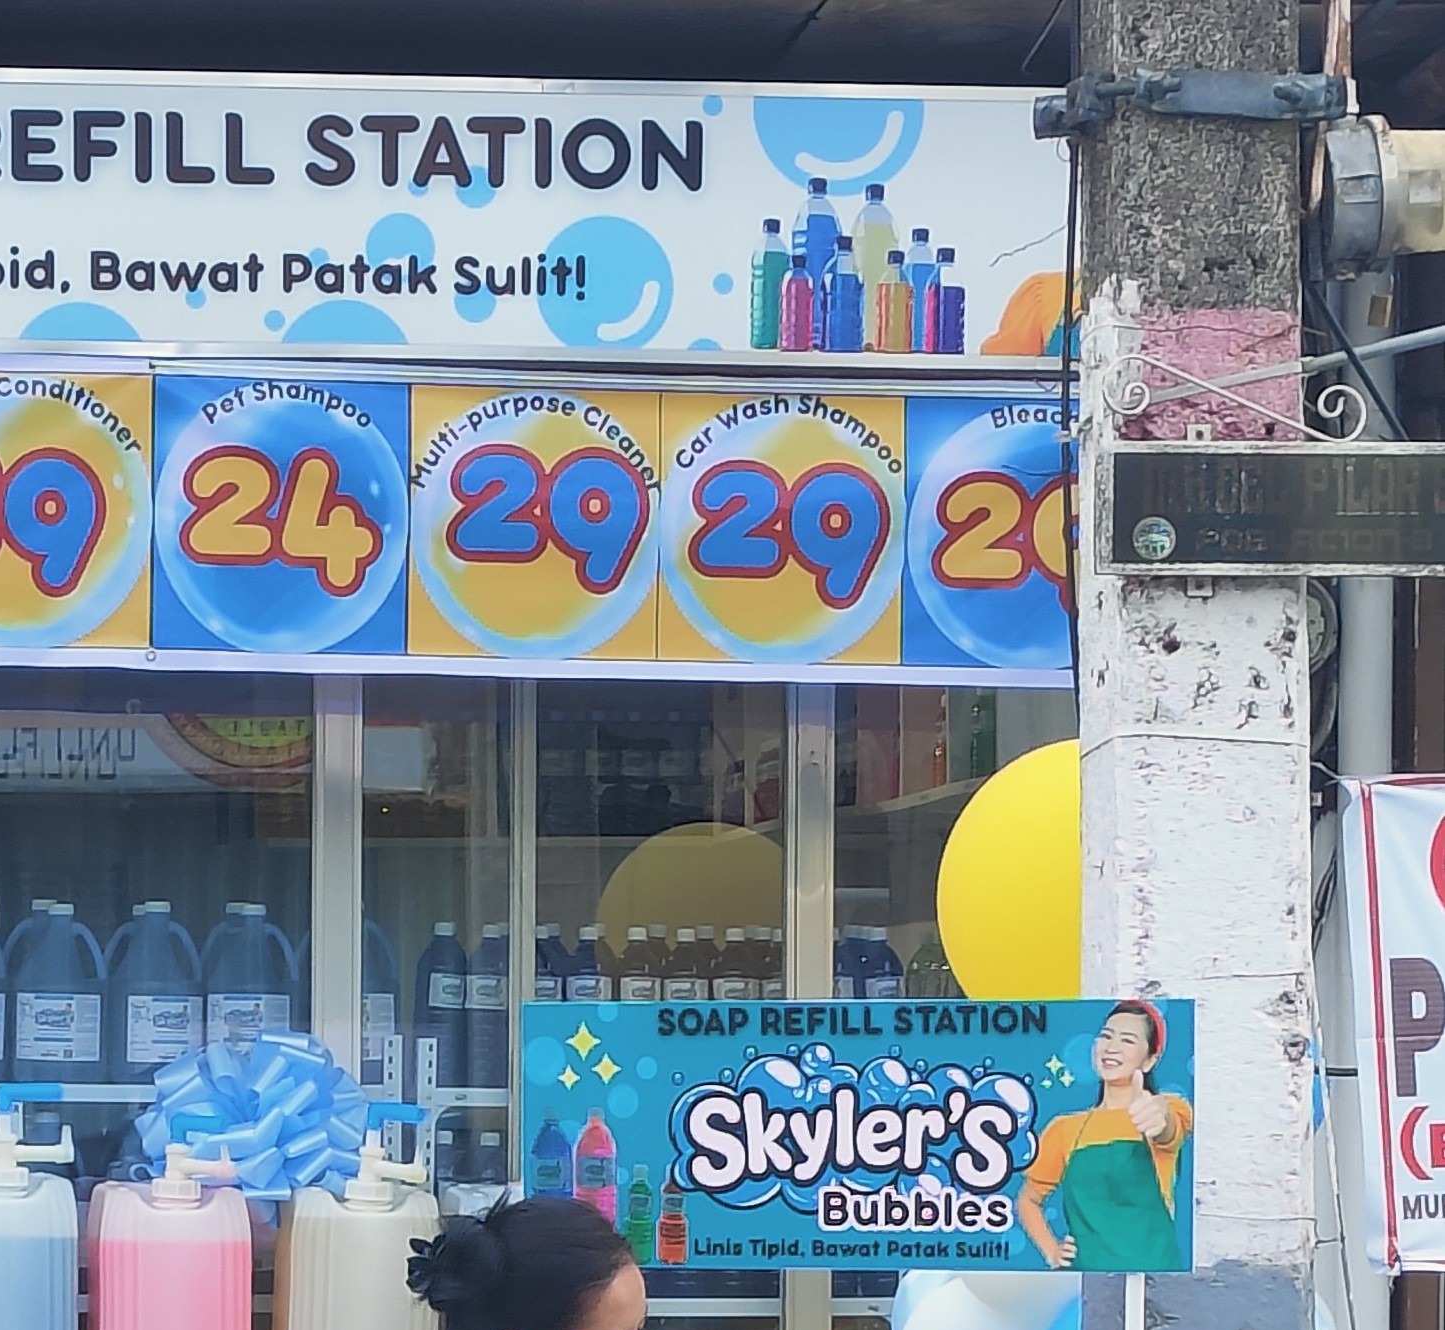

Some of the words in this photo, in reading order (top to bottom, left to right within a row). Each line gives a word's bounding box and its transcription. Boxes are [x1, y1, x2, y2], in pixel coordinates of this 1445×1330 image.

[305, 113, 704, 193] STATION
[90, 251, 264, 293] Bawat
[282, 252, 437, 295] Patak
[453, 253, 588, 302] Sulit!
[201, 386, 248, 425] Pet
[251, 379, 372, 430] Shampoo
[674, 424, 716, 472] Car
[717, 394, 791, 440] Wash
[797, 393, 904, 476] Shampoo
[410, 394, 575, 492] Multi-purpose
[581, 401, 660, 496] Cleaner
[179, 445, 383, 598] 24
[446, 443, 652, 596] 29
[688, 459, 891, 611] 29
[658, 1008, 749, 1037] SOAP
[760, 1006, 887, 1036] REFILL
[895, 1005, 1048, 1036] STATION
[694, 1238, 743, 1257] Linis
[812, 1239, 881, 1258] Bawat
[887, 1240, 950, 1258] Patak
[824, 1192, 1010, 1229] Bubbles
